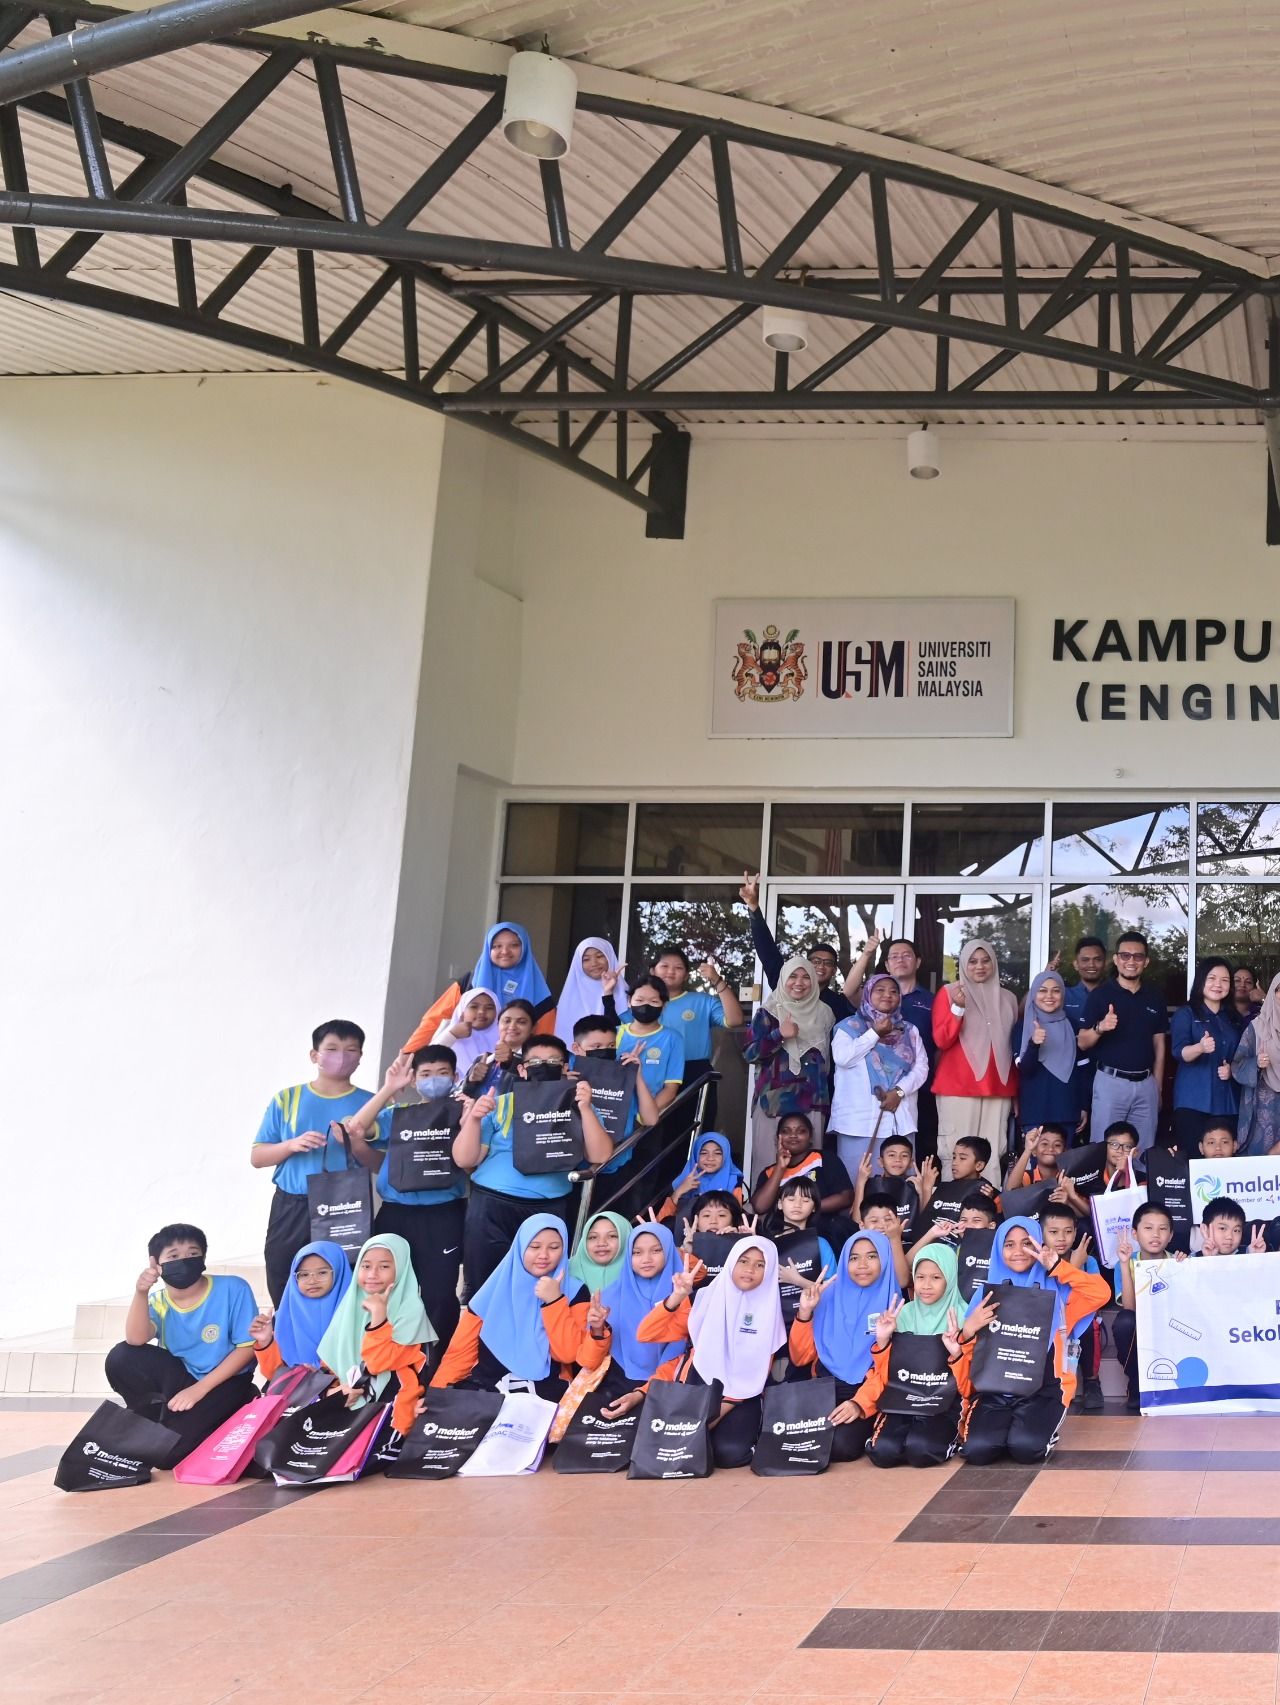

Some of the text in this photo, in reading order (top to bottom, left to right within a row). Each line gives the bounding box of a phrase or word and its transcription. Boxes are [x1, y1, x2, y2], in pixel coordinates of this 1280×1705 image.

[918, 641, 991, 658] UNIVERSITI
[821, 640, 905, 699] USM
[917, 660, 957, 678] SAINS
[917, 680, 983, 697] MALAYSIA
[535, 1110, 572, 1120] malakoff
[413, 1128, 451, 1137] malakoff
[1001, 1323, 1041, 1336] malakoff
[910, 1372, 948, 1381] malakoff
[786, 1417, 826, 1430] malakoff
[437, 1427, 479, 1436] malakoff
